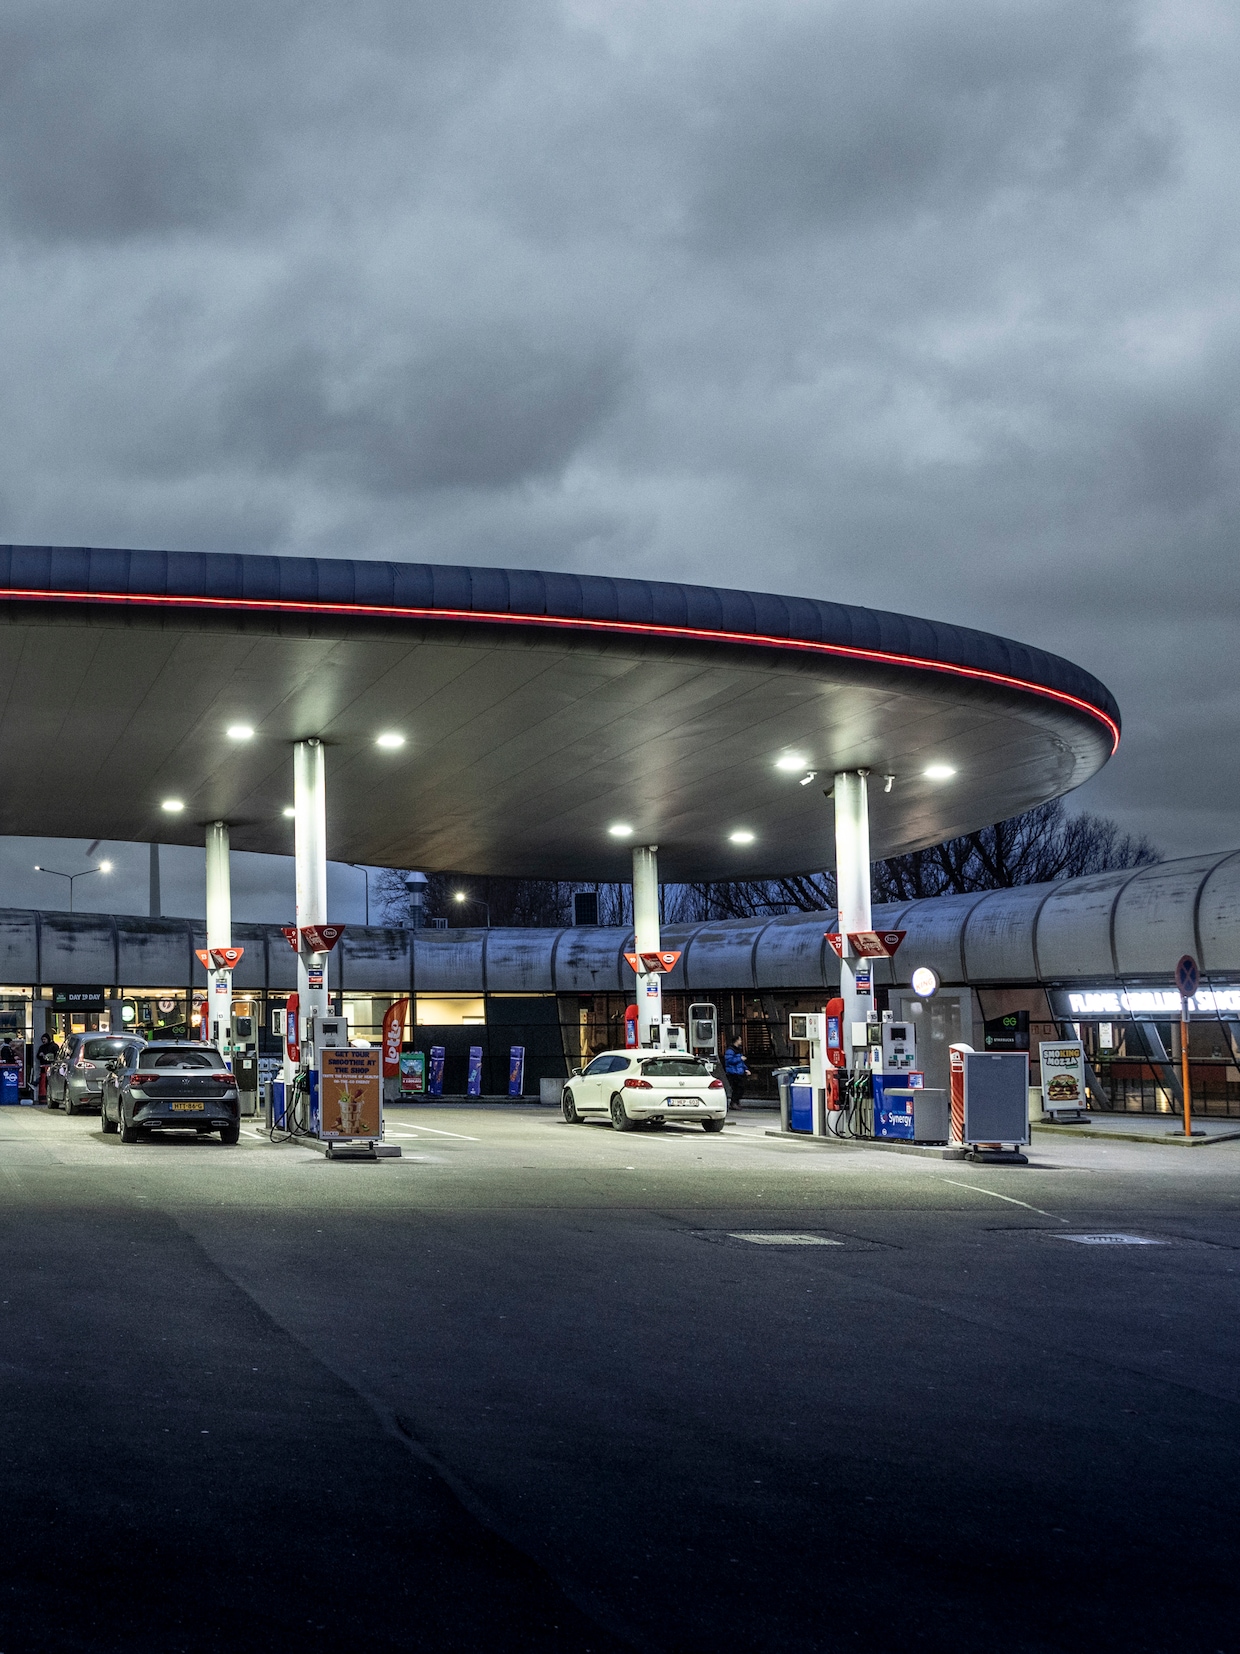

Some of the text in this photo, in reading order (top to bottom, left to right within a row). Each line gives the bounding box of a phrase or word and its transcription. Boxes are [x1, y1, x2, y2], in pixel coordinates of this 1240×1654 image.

[916, 977, 933, 991] KING
[69, 993, 81, 1001] DAY
[88, 993, 101, 1001] DAY
[1044, 1049, 1080, 1059] SMOKING
[1046, 1058, 1078, 1066] MOZZA
[888, 1112, 912, 1127] Synergy
